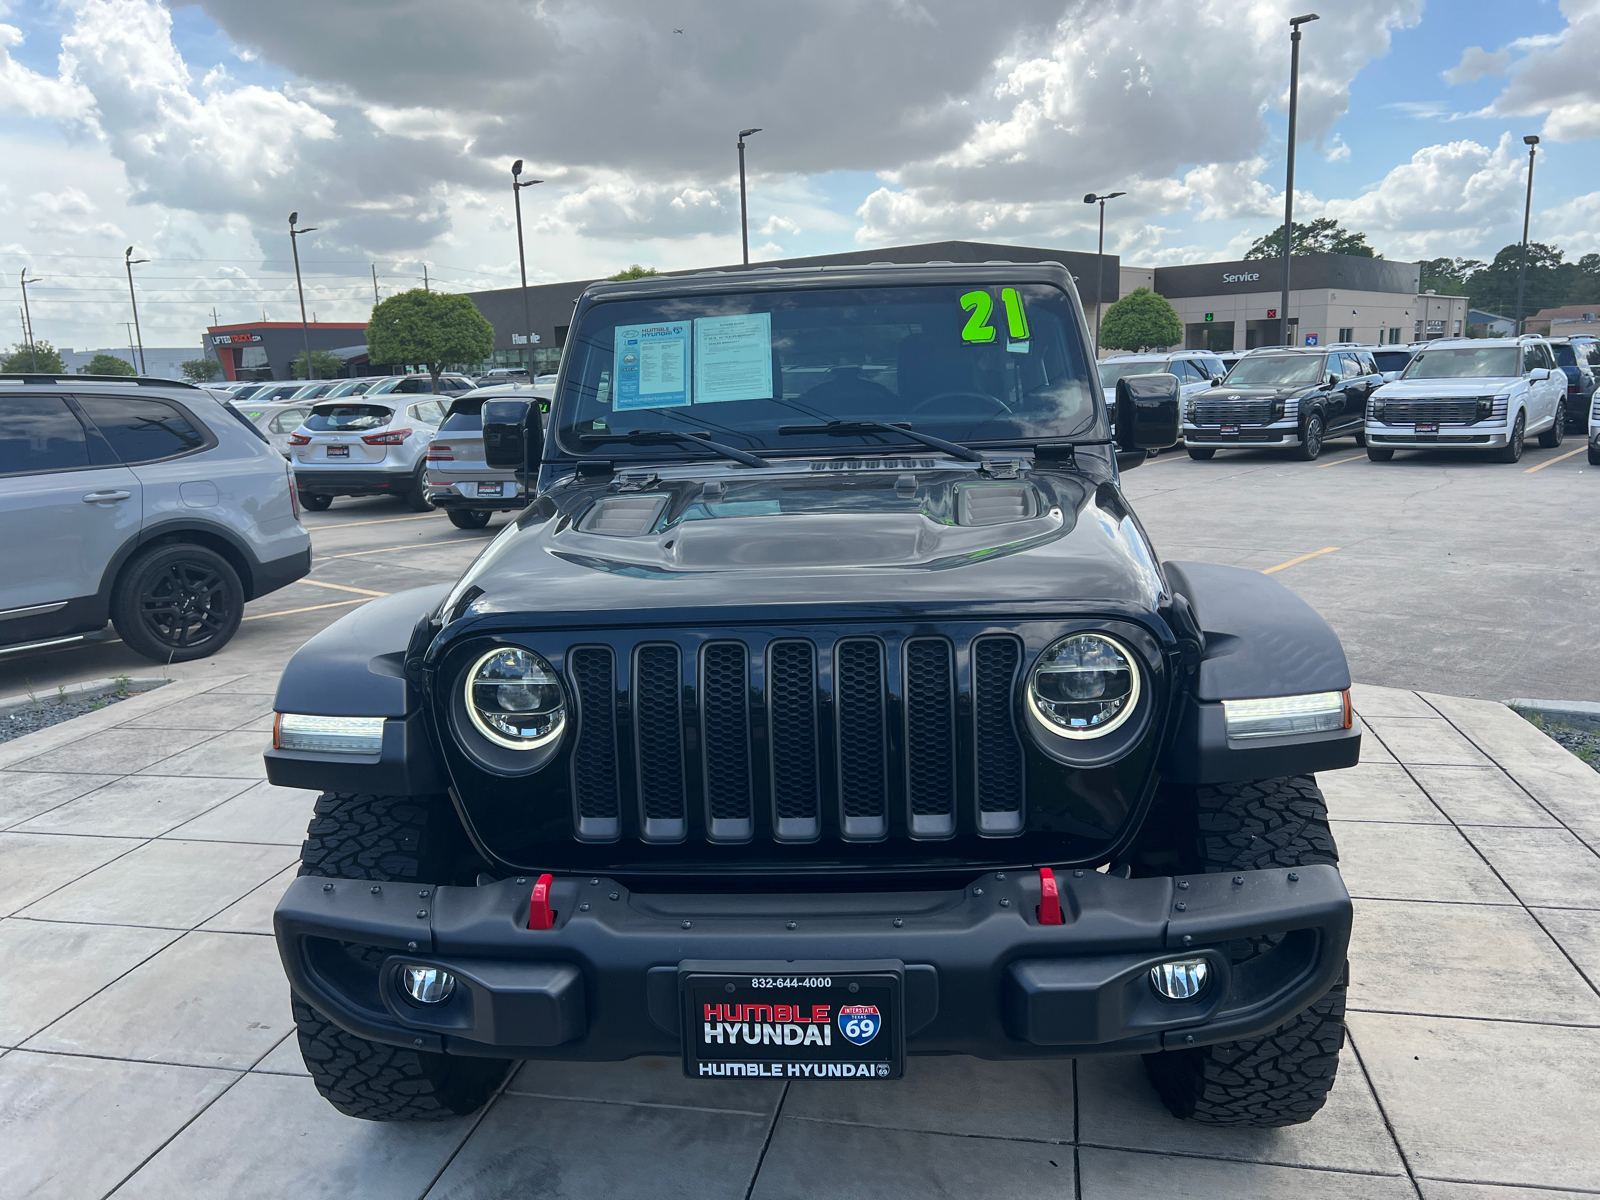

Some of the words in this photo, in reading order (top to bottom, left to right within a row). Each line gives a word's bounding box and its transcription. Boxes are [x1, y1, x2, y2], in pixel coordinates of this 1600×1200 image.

[1222, 271, 1260, 283] Service
[960, 288, 1030, 343] 21
[511, 332, 541, 345] Humle
[751, 977, 832, 989] 832-644-4000
[703, 1003, 831, 1023] HUMBLE
[703, 1022, 832, 1046] HYUNDAI
[845, 1019, 875, 1038] 69
[699, 1063, 783, 1076] HUMBLE
[787, 1063, 875, 1077] HYUNDAI
